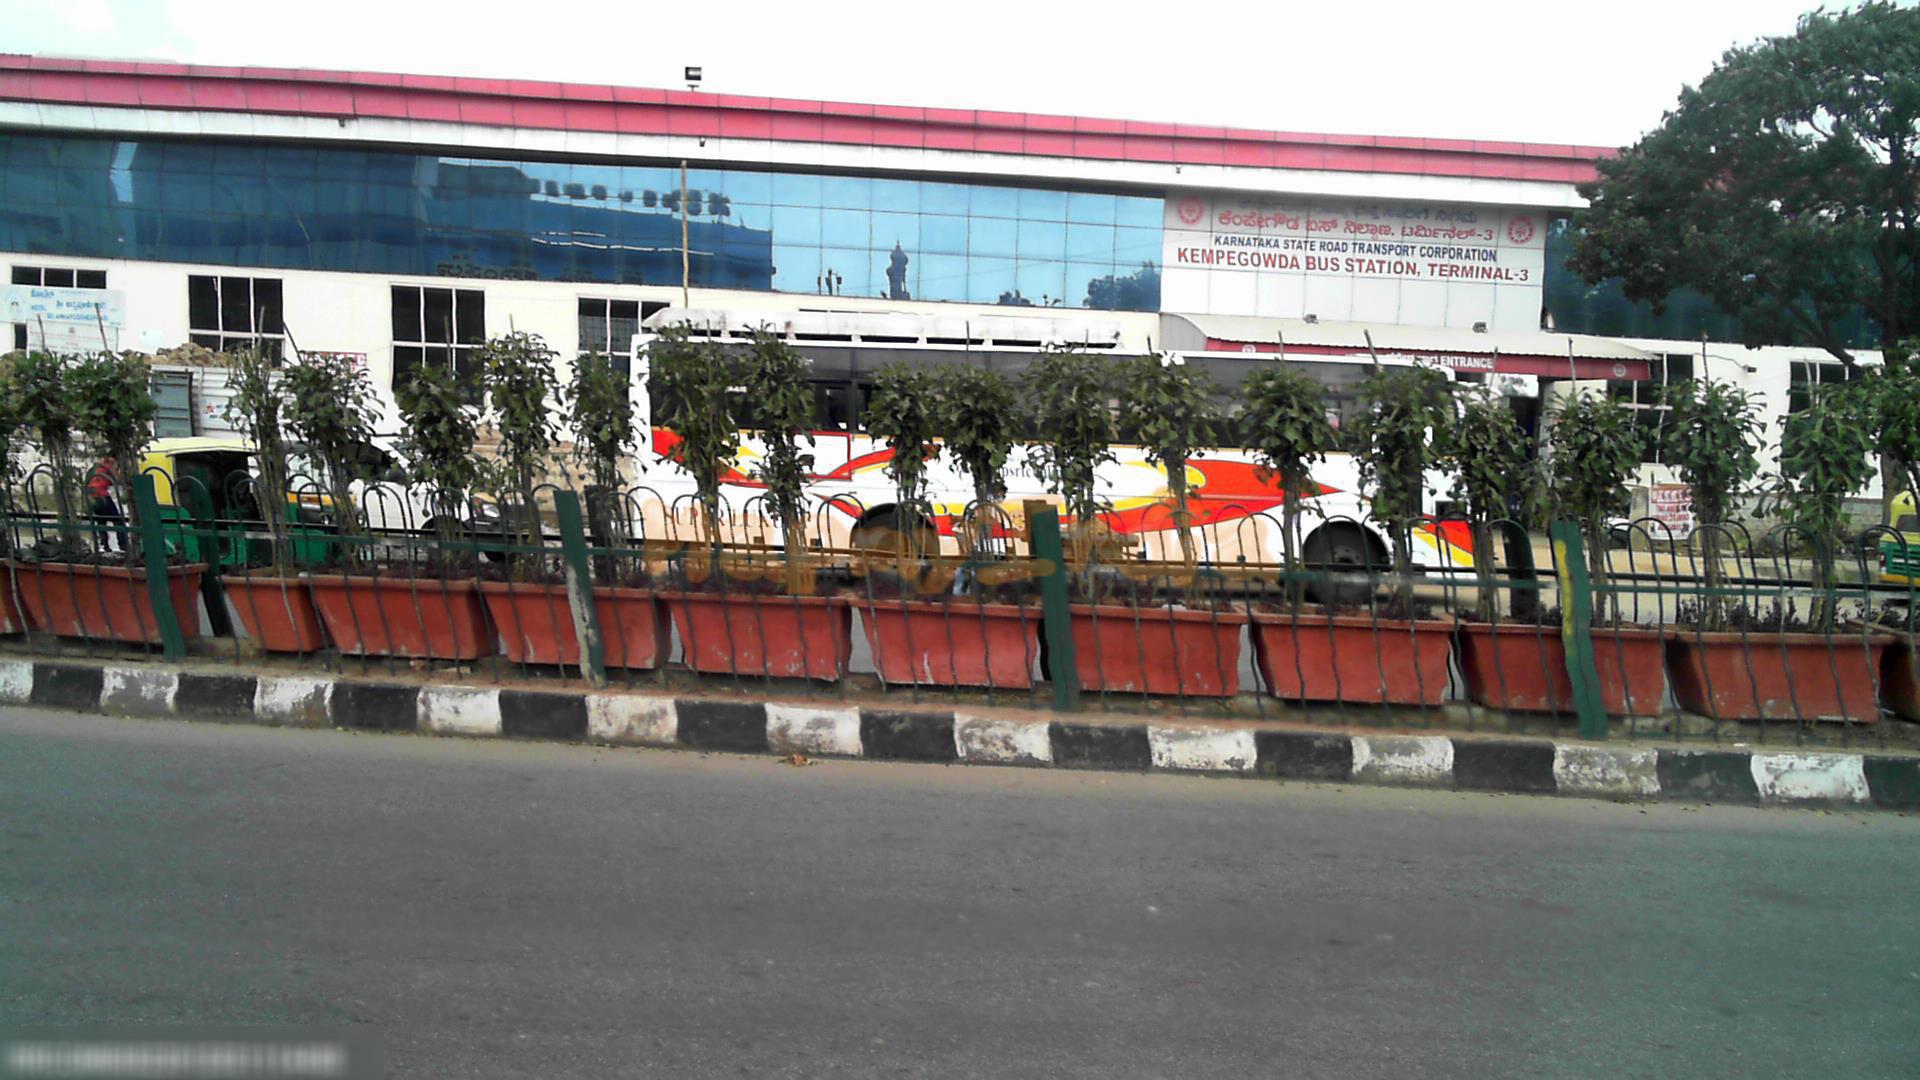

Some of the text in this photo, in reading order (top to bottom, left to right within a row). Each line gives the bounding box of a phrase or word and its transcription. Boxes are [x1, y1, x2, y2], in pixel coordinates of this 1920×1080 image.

[1214, 235, 1497, 262] KARNATAKA STATE ROAD TRANSPORT CORPORATION
[1178, 247, 1529, 281] KEMPEGOWDA BUS STATION, TERMINAL-3
[1441, 355, 1494, 369] ENTRANCE
